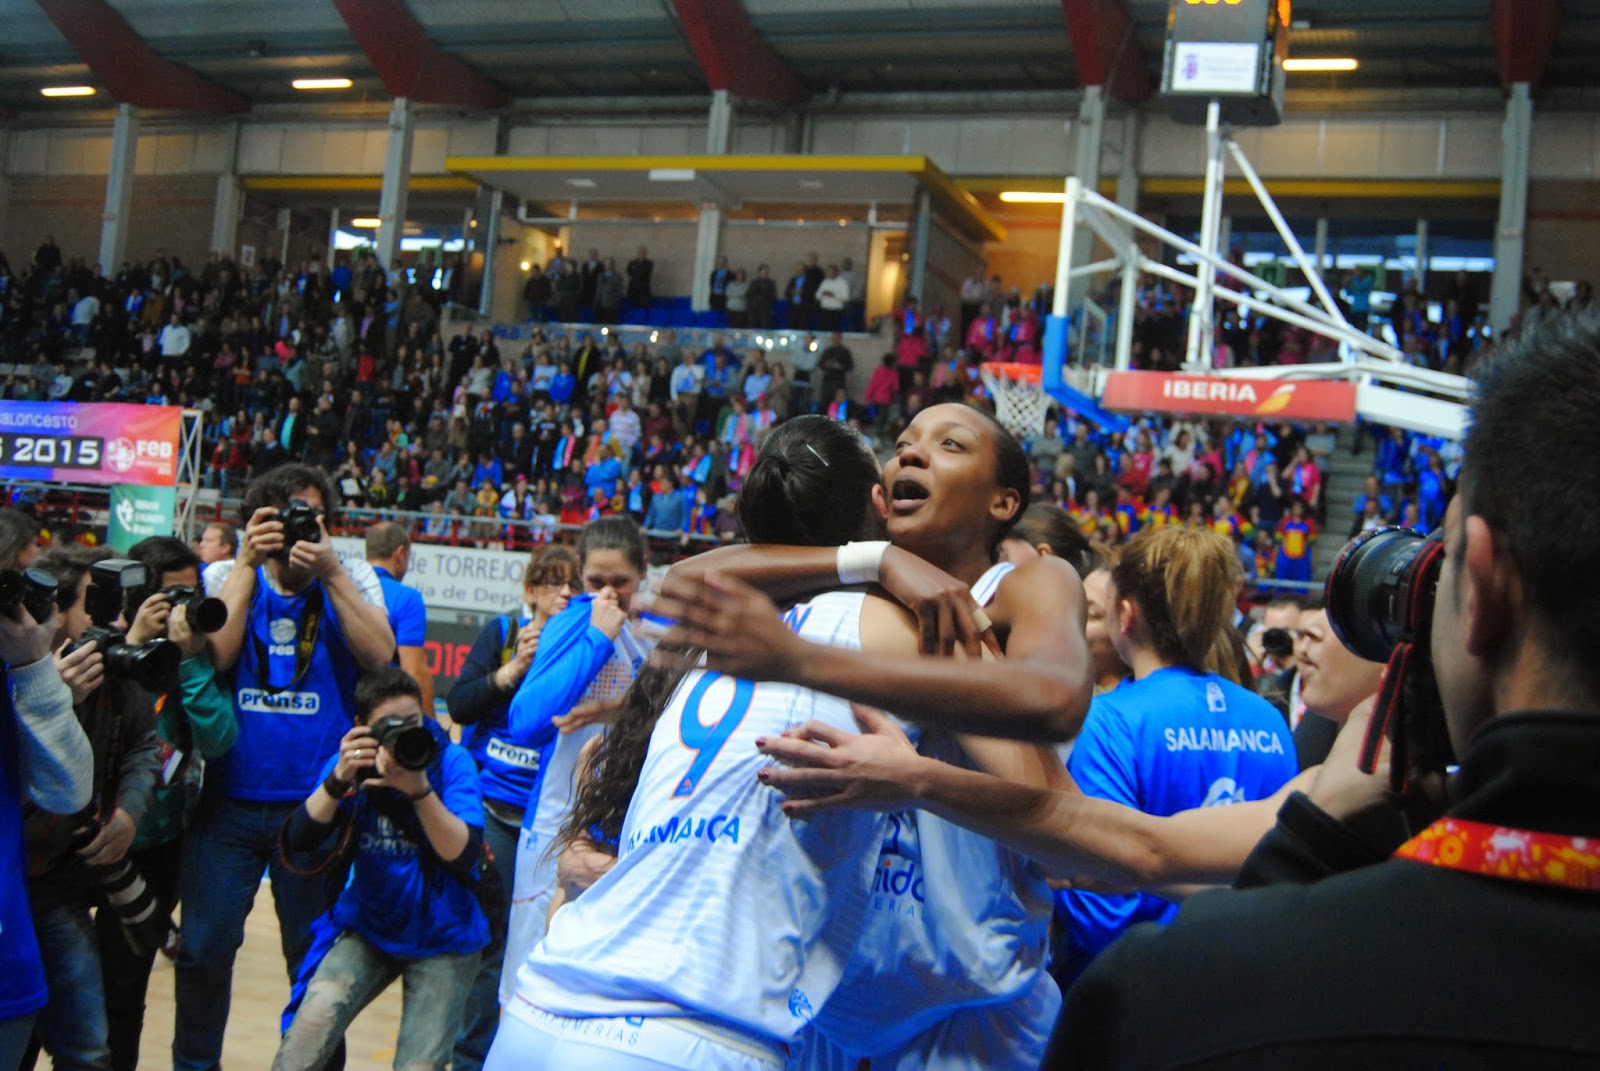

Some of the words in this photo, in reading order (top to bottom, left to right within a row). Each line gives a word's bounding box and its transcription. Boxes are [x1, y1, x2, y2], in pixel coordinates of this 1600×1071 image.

[1164, 380, 1257, 402] IBERIA
[13, 437, 99, 465] 2015
[442, 584, 466, 600] de
[670, 669, 756, 800] 9
[1164, 726, 1284, 755] SALAMANCA
